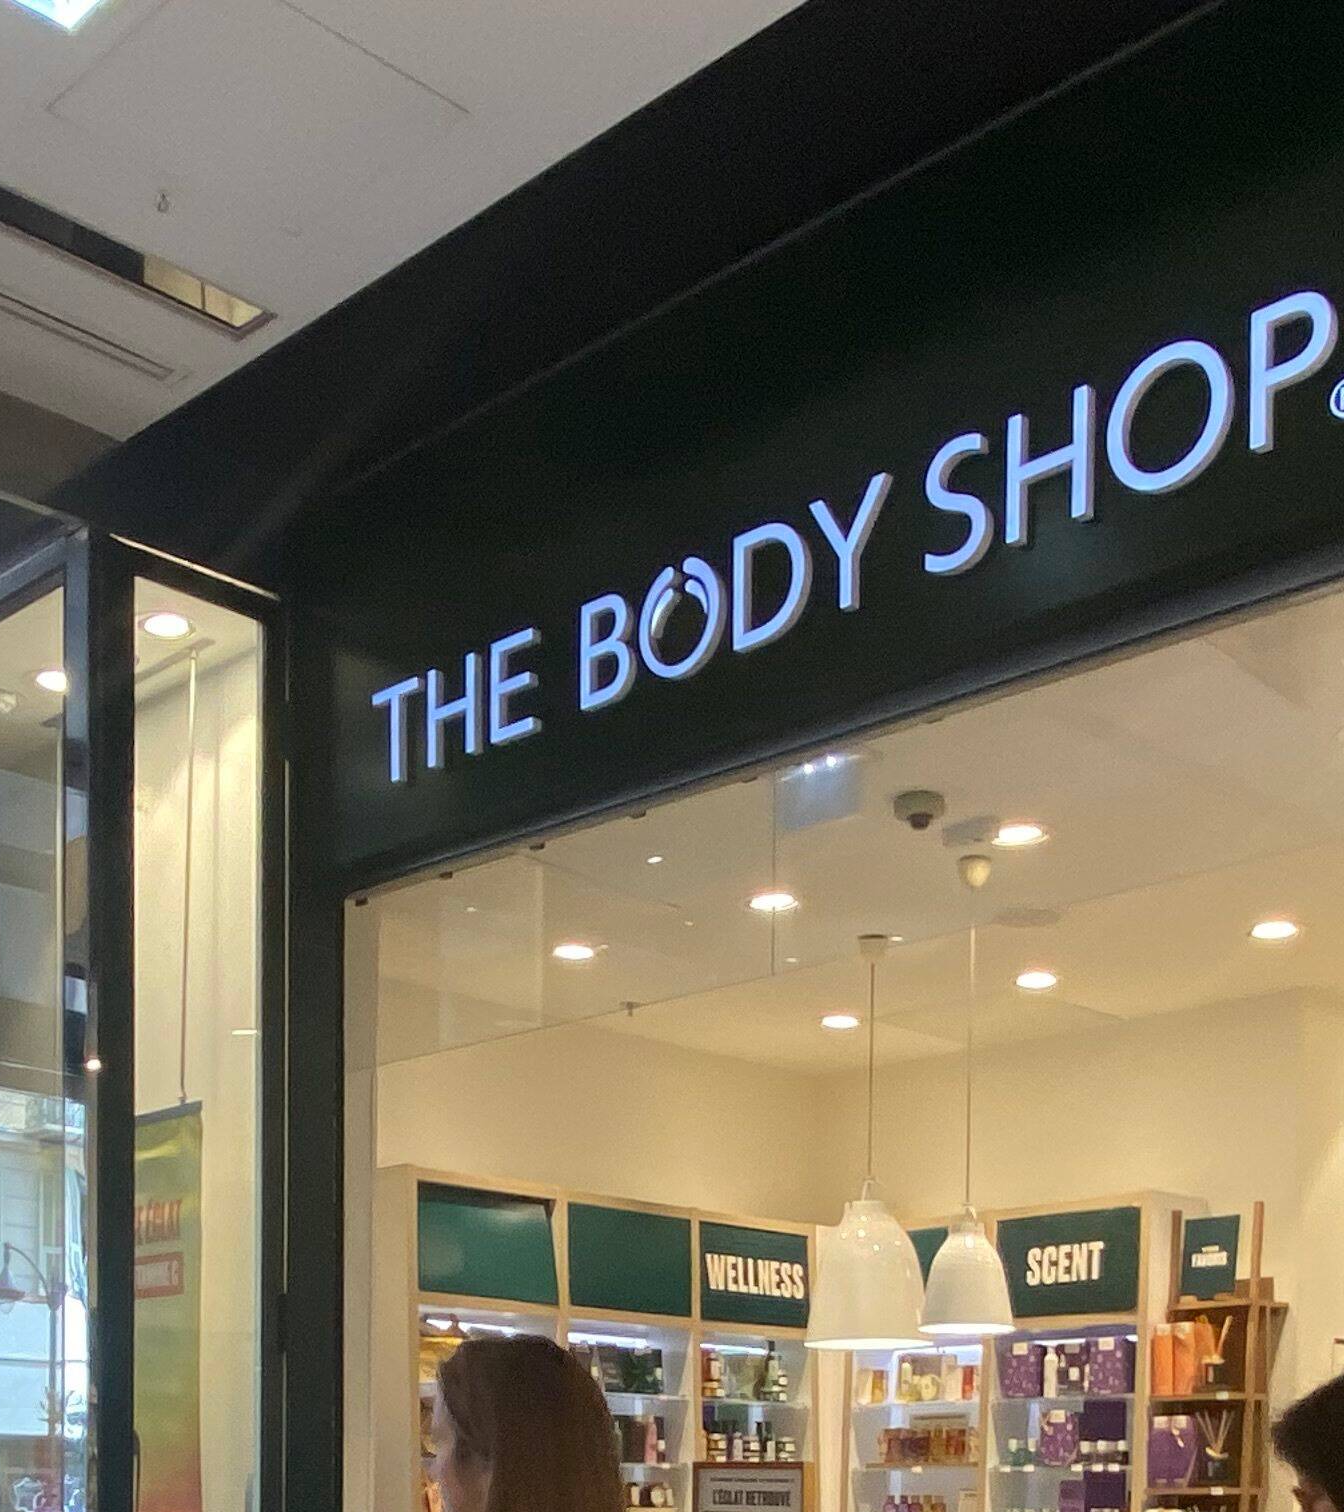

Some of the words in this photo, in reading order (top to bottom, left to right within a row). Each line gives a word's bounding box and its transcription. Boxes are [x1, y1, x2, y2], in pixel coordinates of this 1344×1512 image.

[372, 627, 542, 784] THE
[580, 472, 894, 712] BODY
[704, 1252, 805, 1300] WELLNESS
[1026, 1240, 1105, 1287] SCENT
